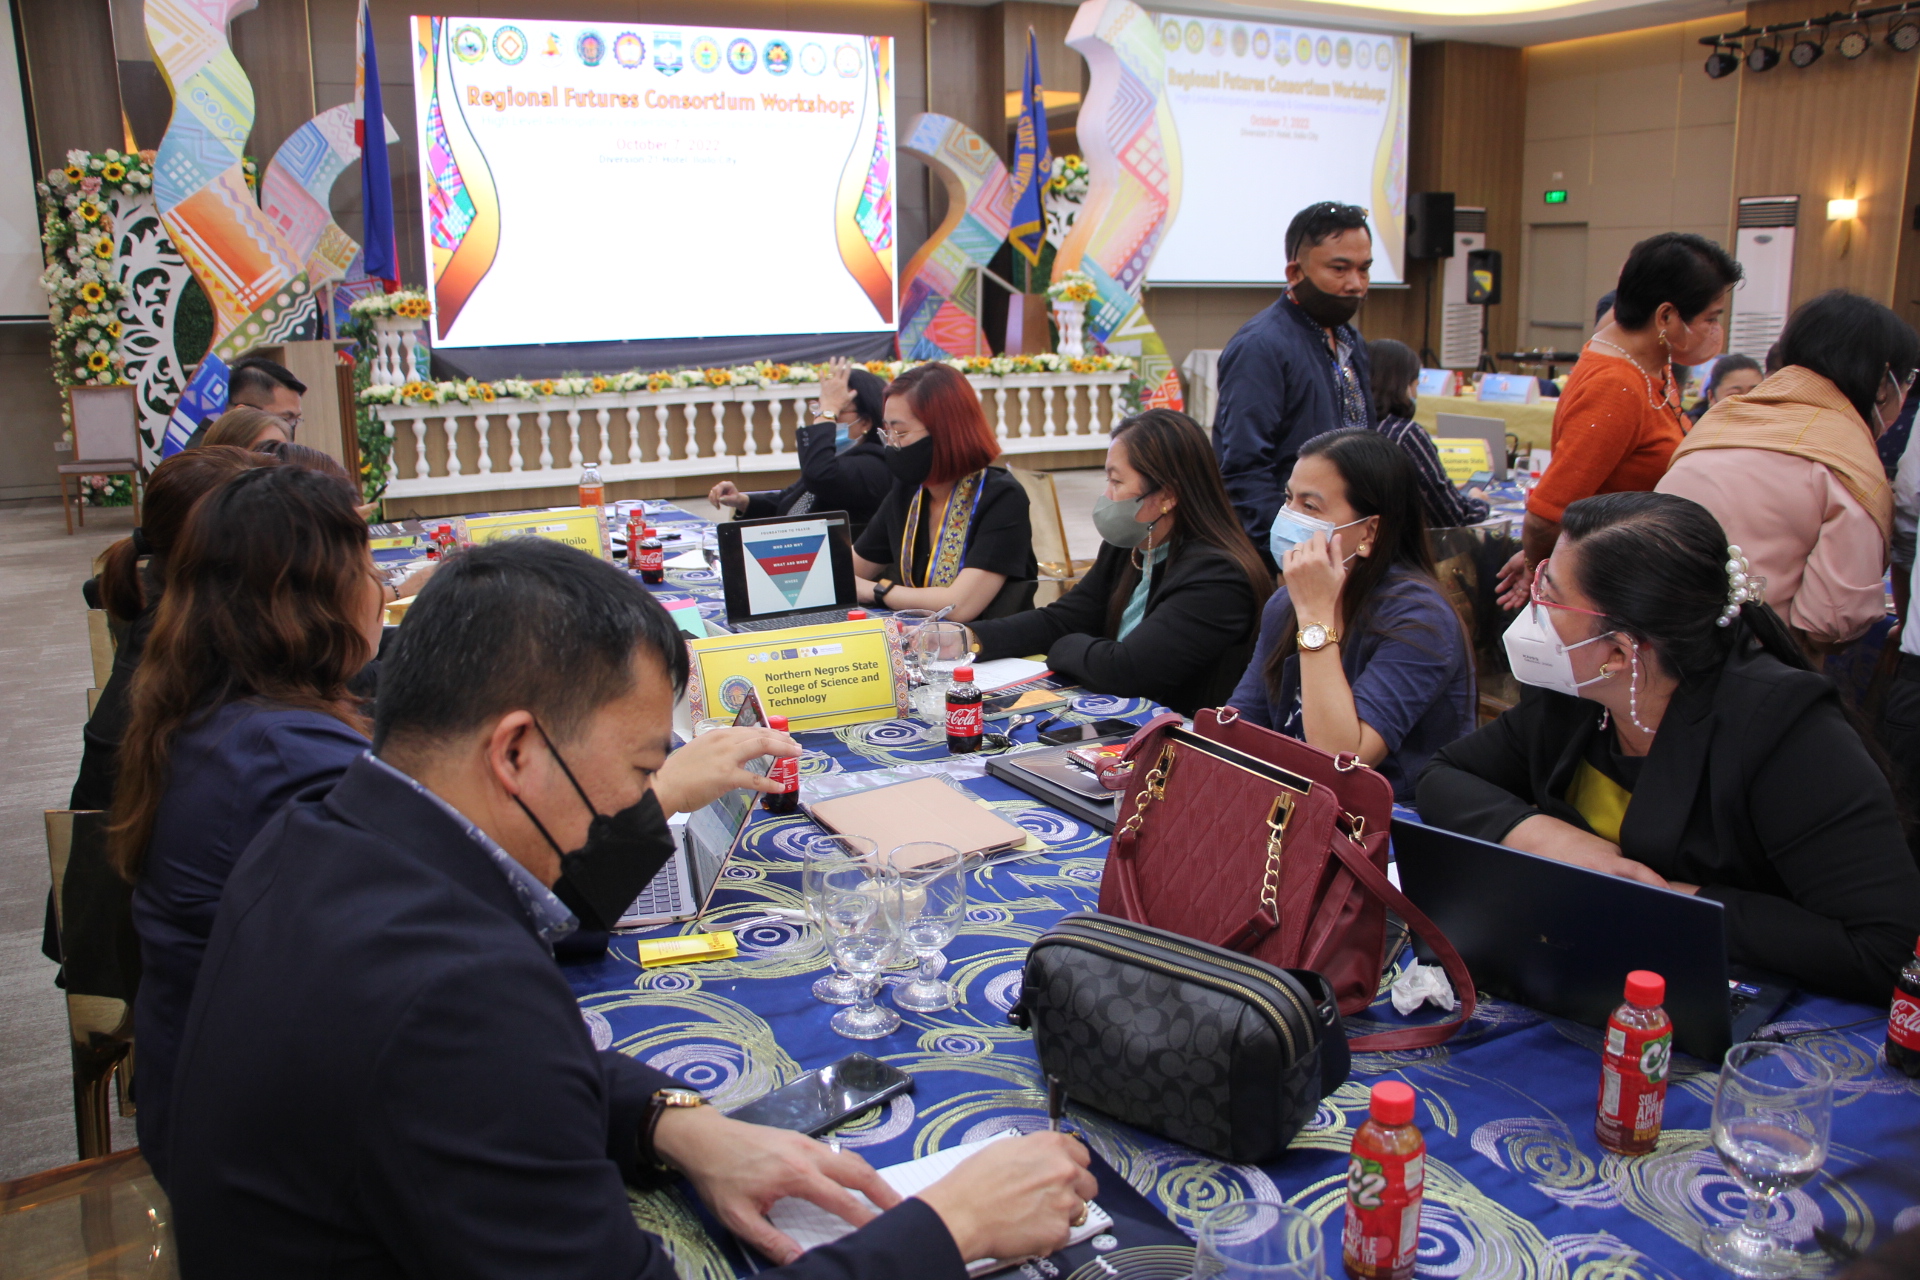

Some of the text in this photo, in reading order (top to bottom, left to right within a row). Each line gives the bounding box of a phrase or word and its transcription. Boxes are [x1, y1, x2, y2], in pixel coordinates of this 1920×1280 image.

[467, 85, 855, 118] Regional Futures Consortium Workshop:
[1017, 116, 1036, 149] STATE
[616, 138, 667, 150] October
[689, 139, 720, 151] 2022
[765, 660, 879, 682] Northern Negros State
[767, 672, 880, 694] College of Science and
[768, 693, 827, 708] Technology
[1638, 1091, 1658, 1106] SOLO
[1347, 1158, 1387, 1207] C2
